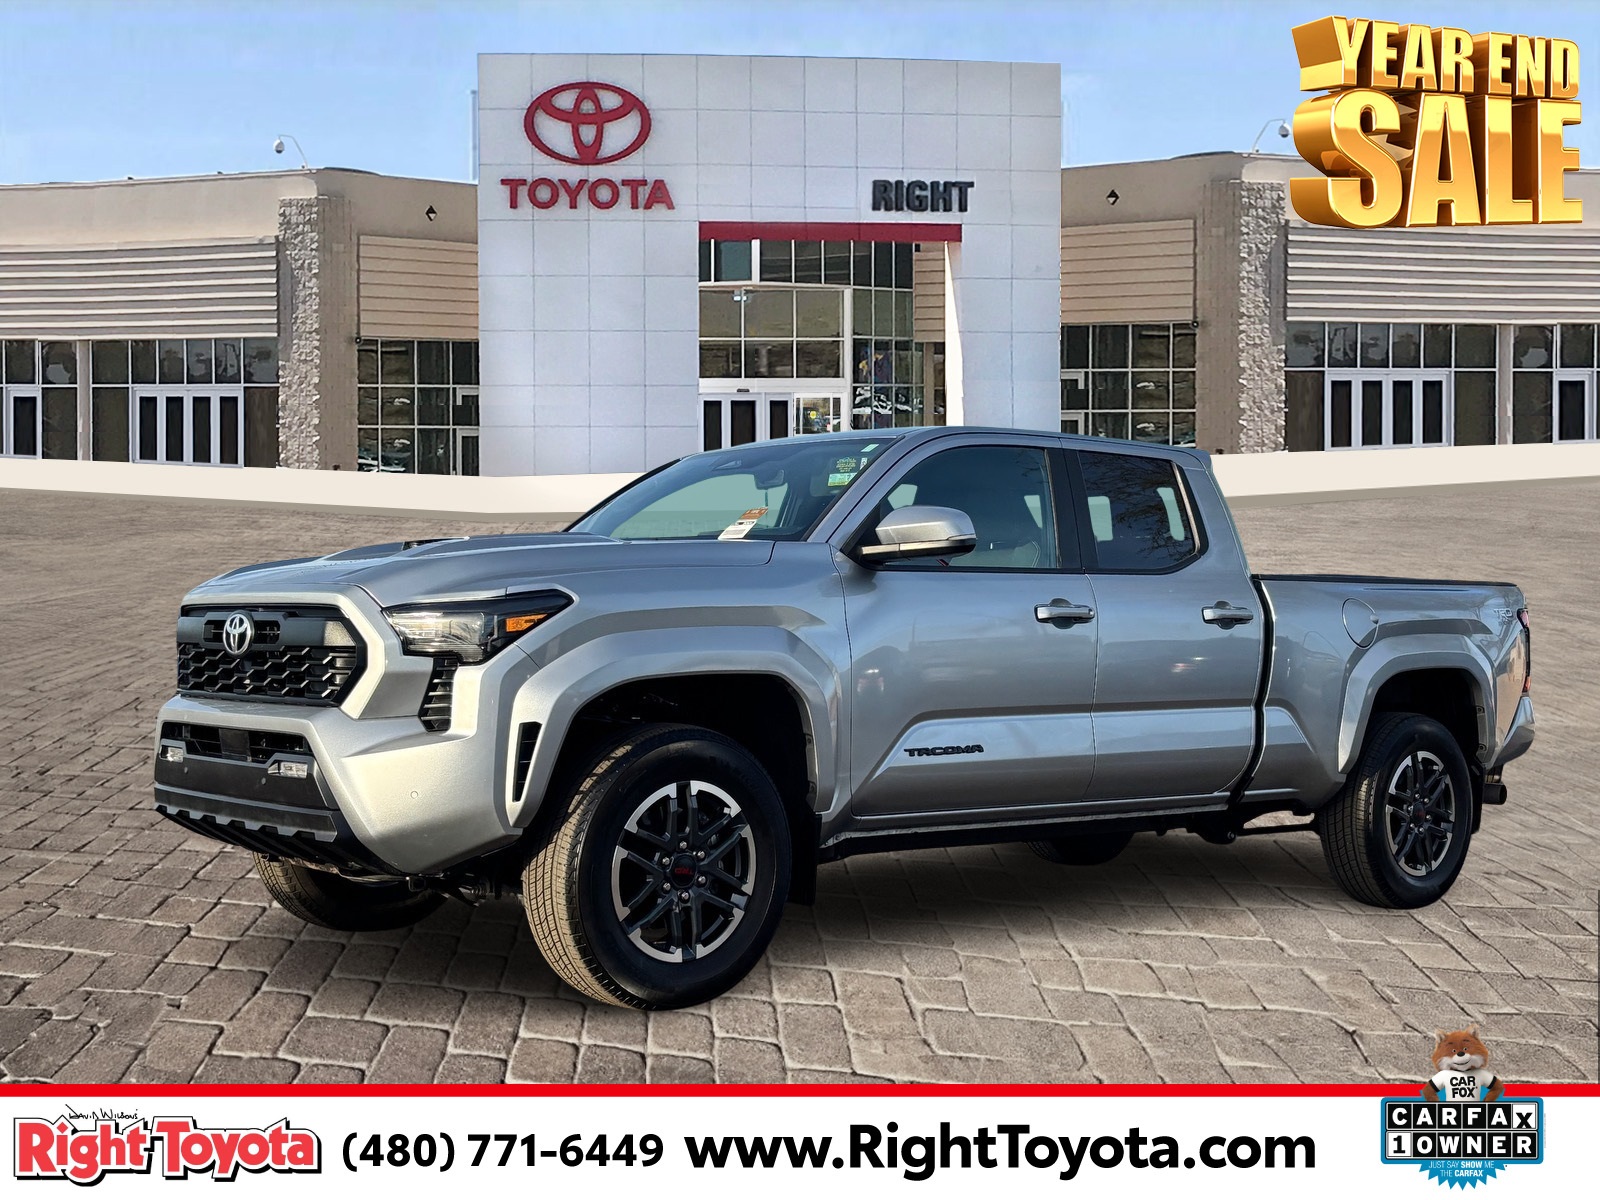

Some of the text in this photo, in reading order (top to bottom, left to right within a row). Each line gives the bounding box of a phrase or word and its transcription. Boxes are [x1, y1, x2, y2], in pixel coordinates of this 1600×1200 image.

[500, 177, 676, 210] TOYOTA
[872, 179, 975, 212] RIGHT
[903, 744, 985, 757] TACOMA
